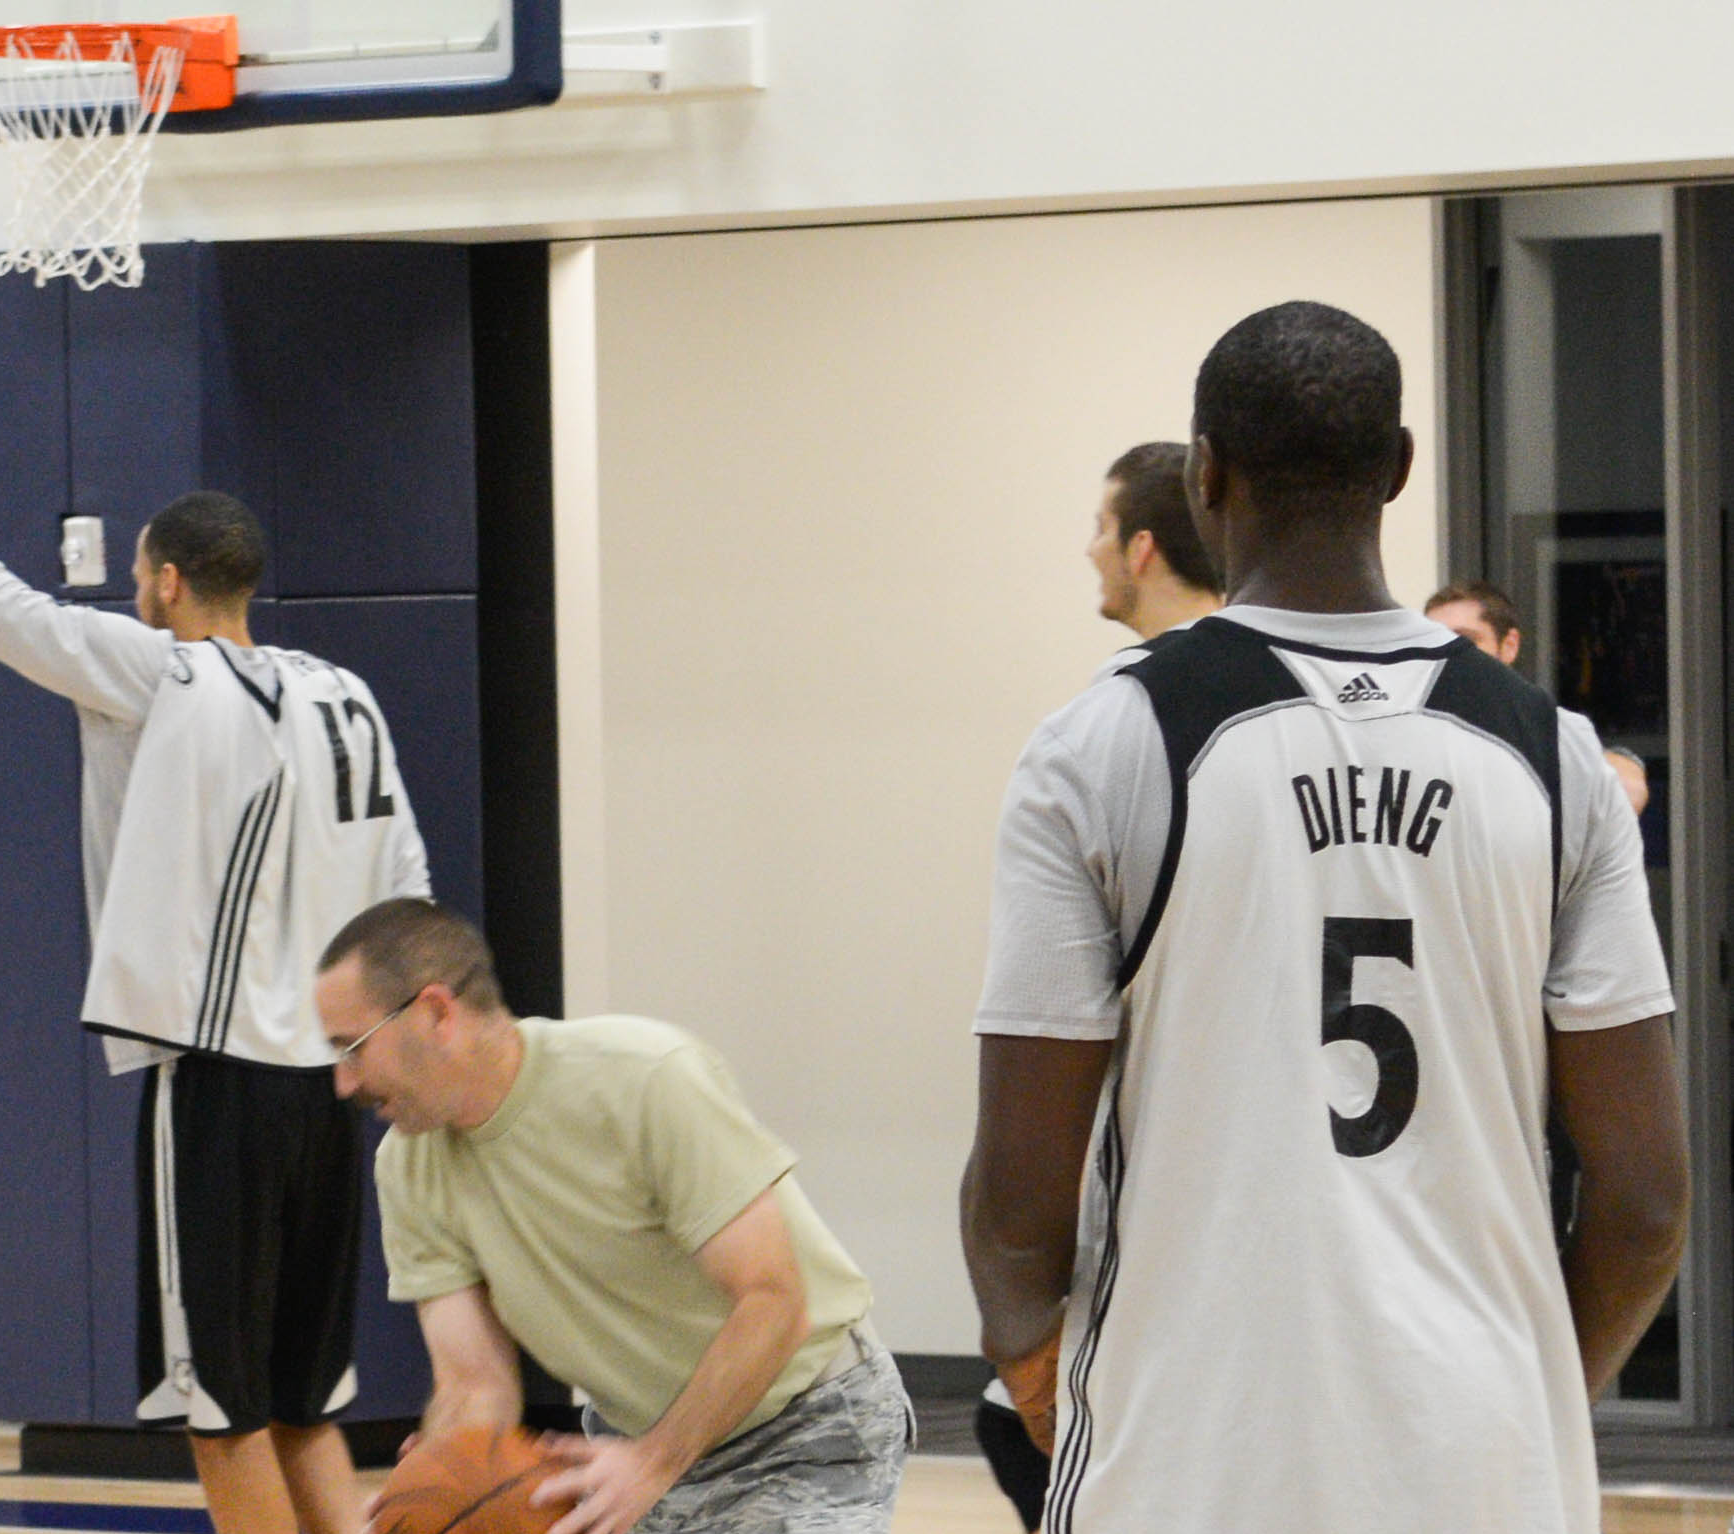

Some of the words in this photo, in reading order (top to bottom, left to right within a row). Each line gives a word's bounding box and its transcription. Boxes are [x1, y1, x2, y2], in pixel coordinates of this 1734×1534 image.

[1337, 689, 1390, 703] adidas
[313, 697, 395, 823] 12
[1292, 765, 1453, 857] DIENG
[1321, 916, 1419, 1158] 5
